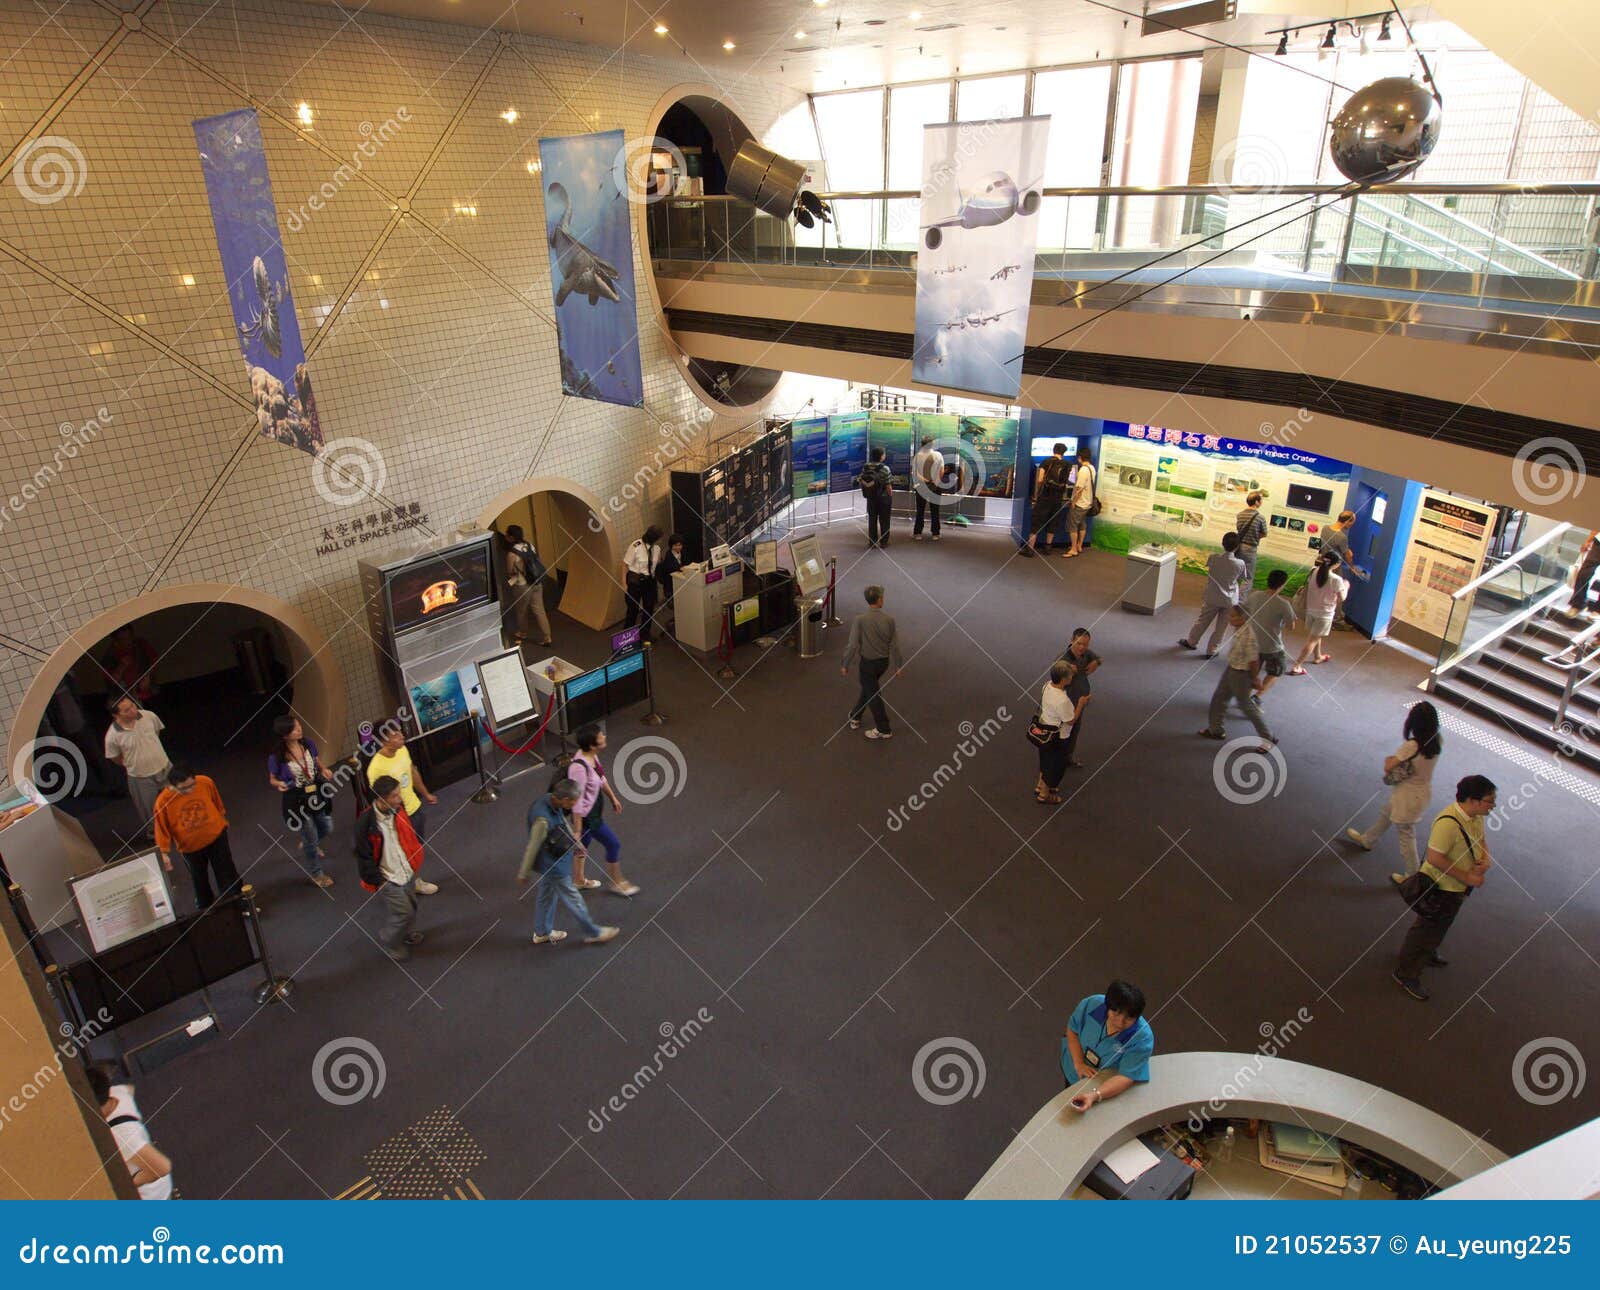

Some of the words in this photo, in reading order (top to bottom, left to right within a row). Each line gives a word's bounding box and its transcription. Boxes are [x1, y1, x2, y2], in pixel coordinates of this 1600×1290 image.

[1239, 445, 1263, 455] Xiuyan
[1264, 449, 1290, 460] Impact
[1291, 453, 1318, 463] Crater
[315, 541, 343, 556] HALL
[343, 537, 357, 548] OF
[359, 526, 391, 543] SPACE
[391, 514, 429, 533] SCIENCE
